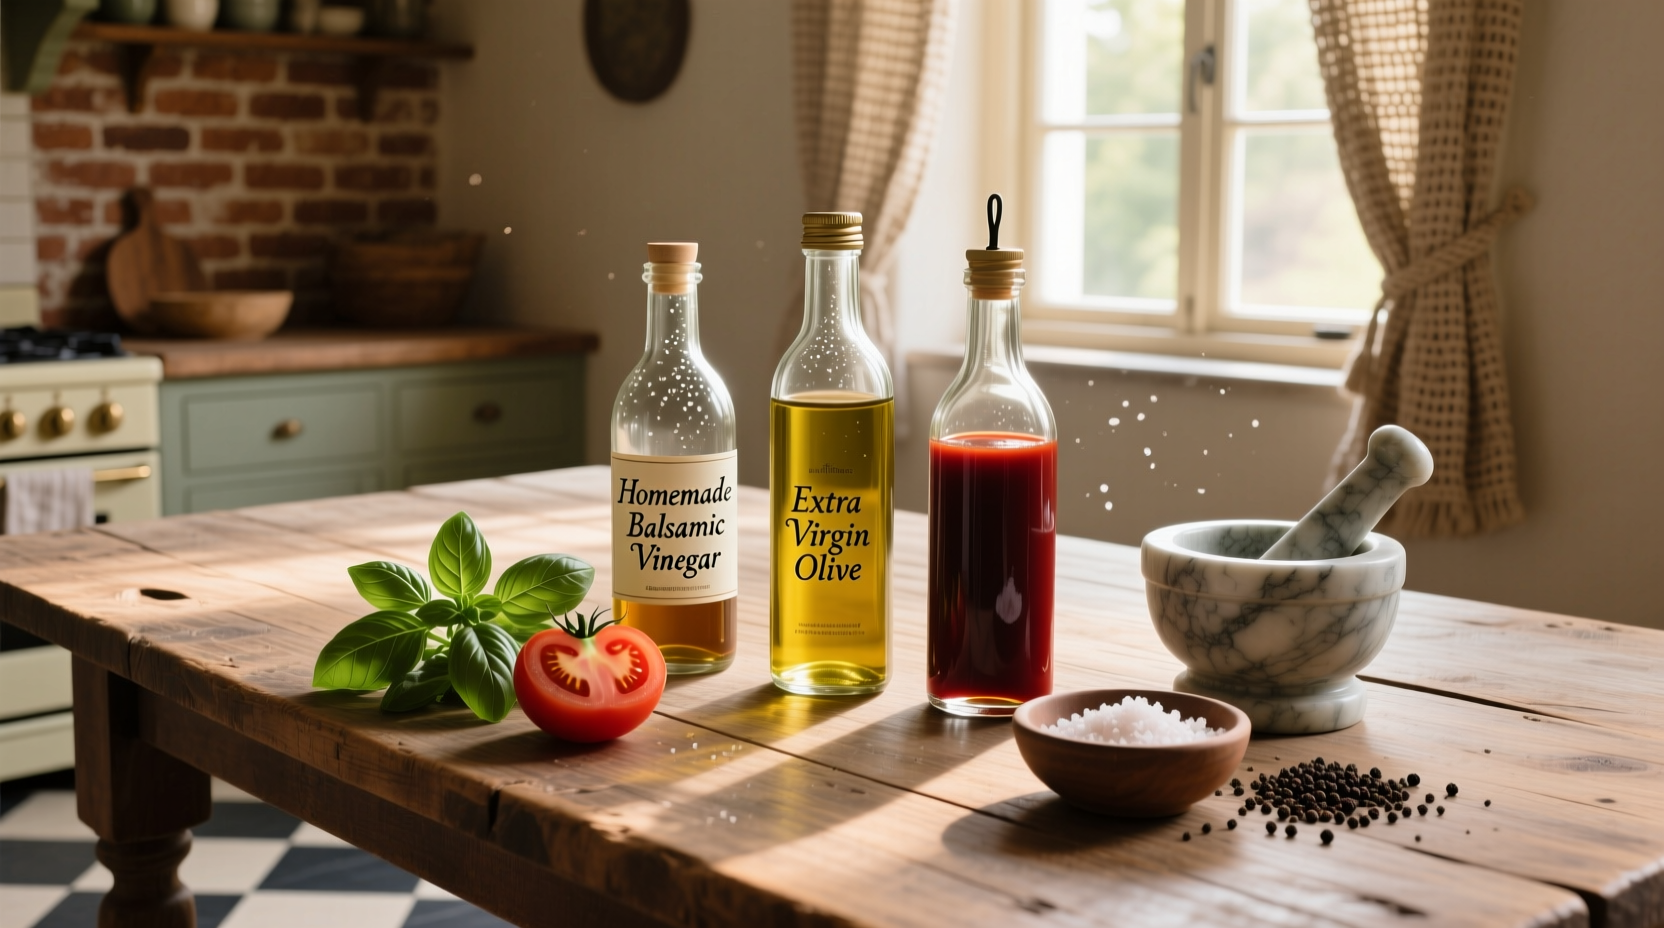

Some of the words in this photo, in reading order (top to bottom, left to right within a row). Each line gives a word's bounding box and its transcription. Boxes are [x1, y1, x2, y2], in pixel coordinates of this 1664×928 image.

[617, 476, 732, 506] Homemade
[791, 485, 861, 514] Extra
[626, 511, 725, 538] Balsamic
[785, 518, 870, 556] Virgin
[630, 543, 721, 579] Vinegar
[795, 553, 862, 581] Olive
